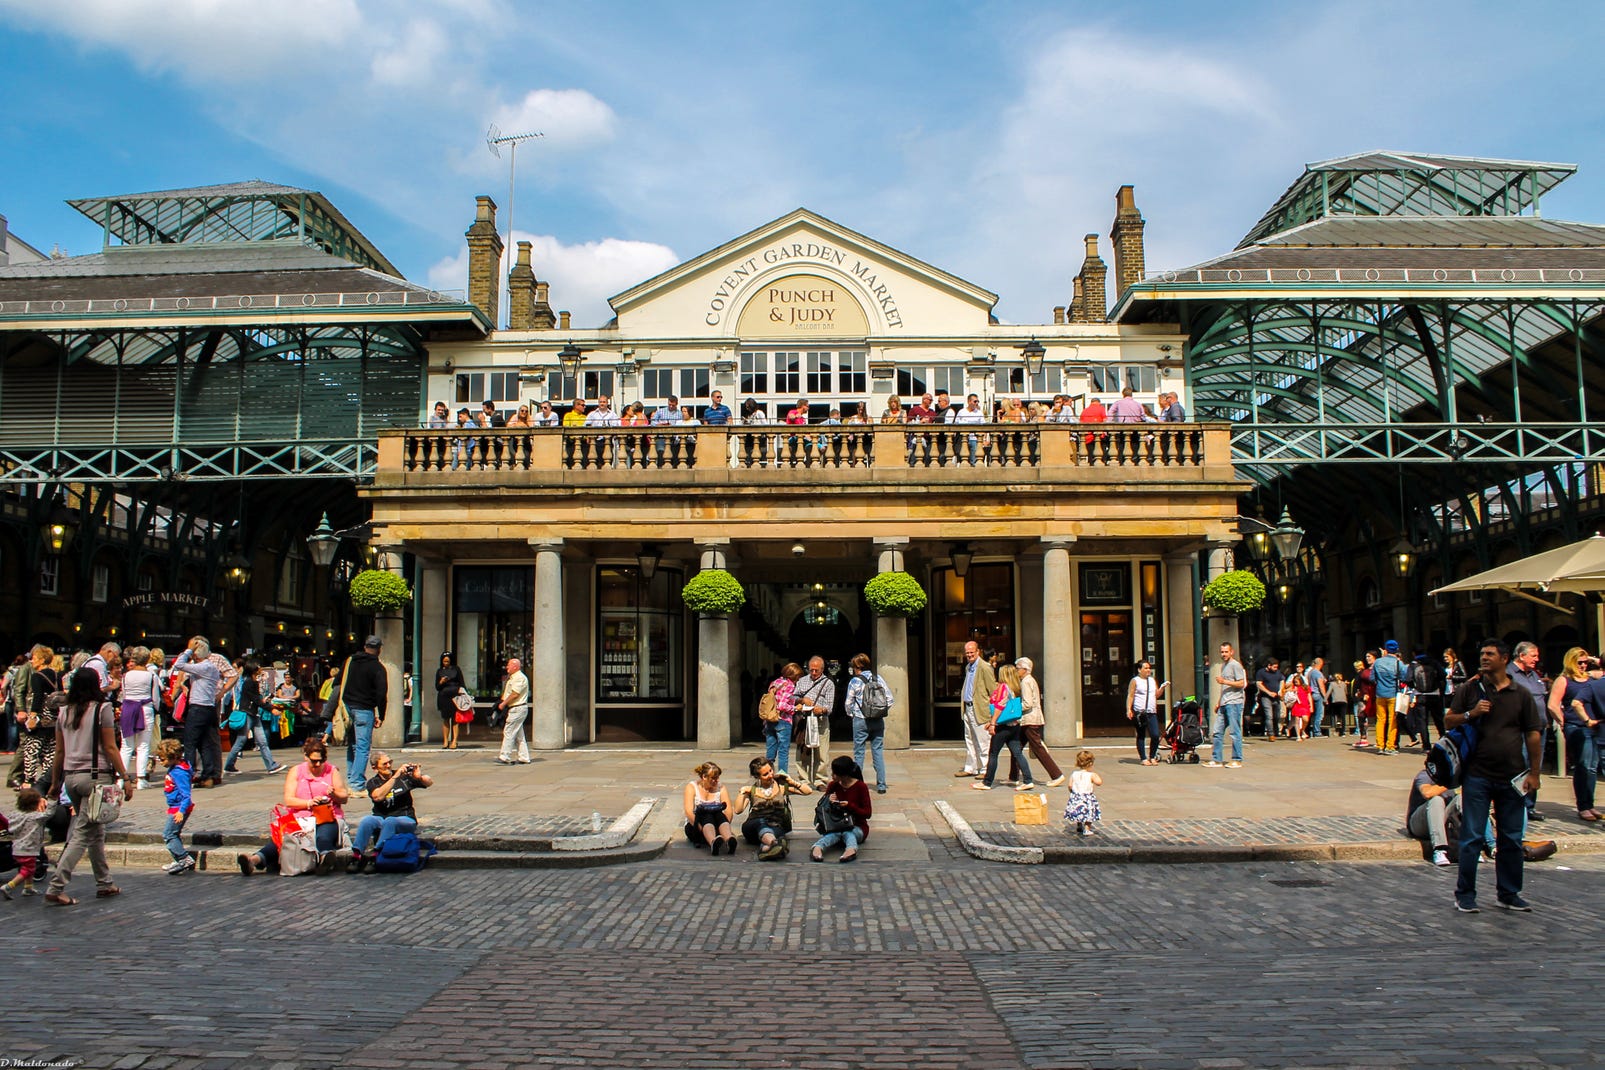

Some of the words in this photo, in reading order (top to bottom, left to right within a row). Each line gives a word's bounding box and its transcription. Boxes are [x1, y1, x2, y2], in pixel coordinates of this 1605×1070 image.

[705, 257, 759, 327] COVENT
[763, 243, 847, 266] GARDEN
[850, 260, 903, 329] MARKET
[769, 288, 834, 303] PUNCH
[769, 307, 783, 322] &
[789, 308, 836, 326] JUDY
[122, 593, 155, 608] APPLE
[160, 592, 208, 607] MARKET
